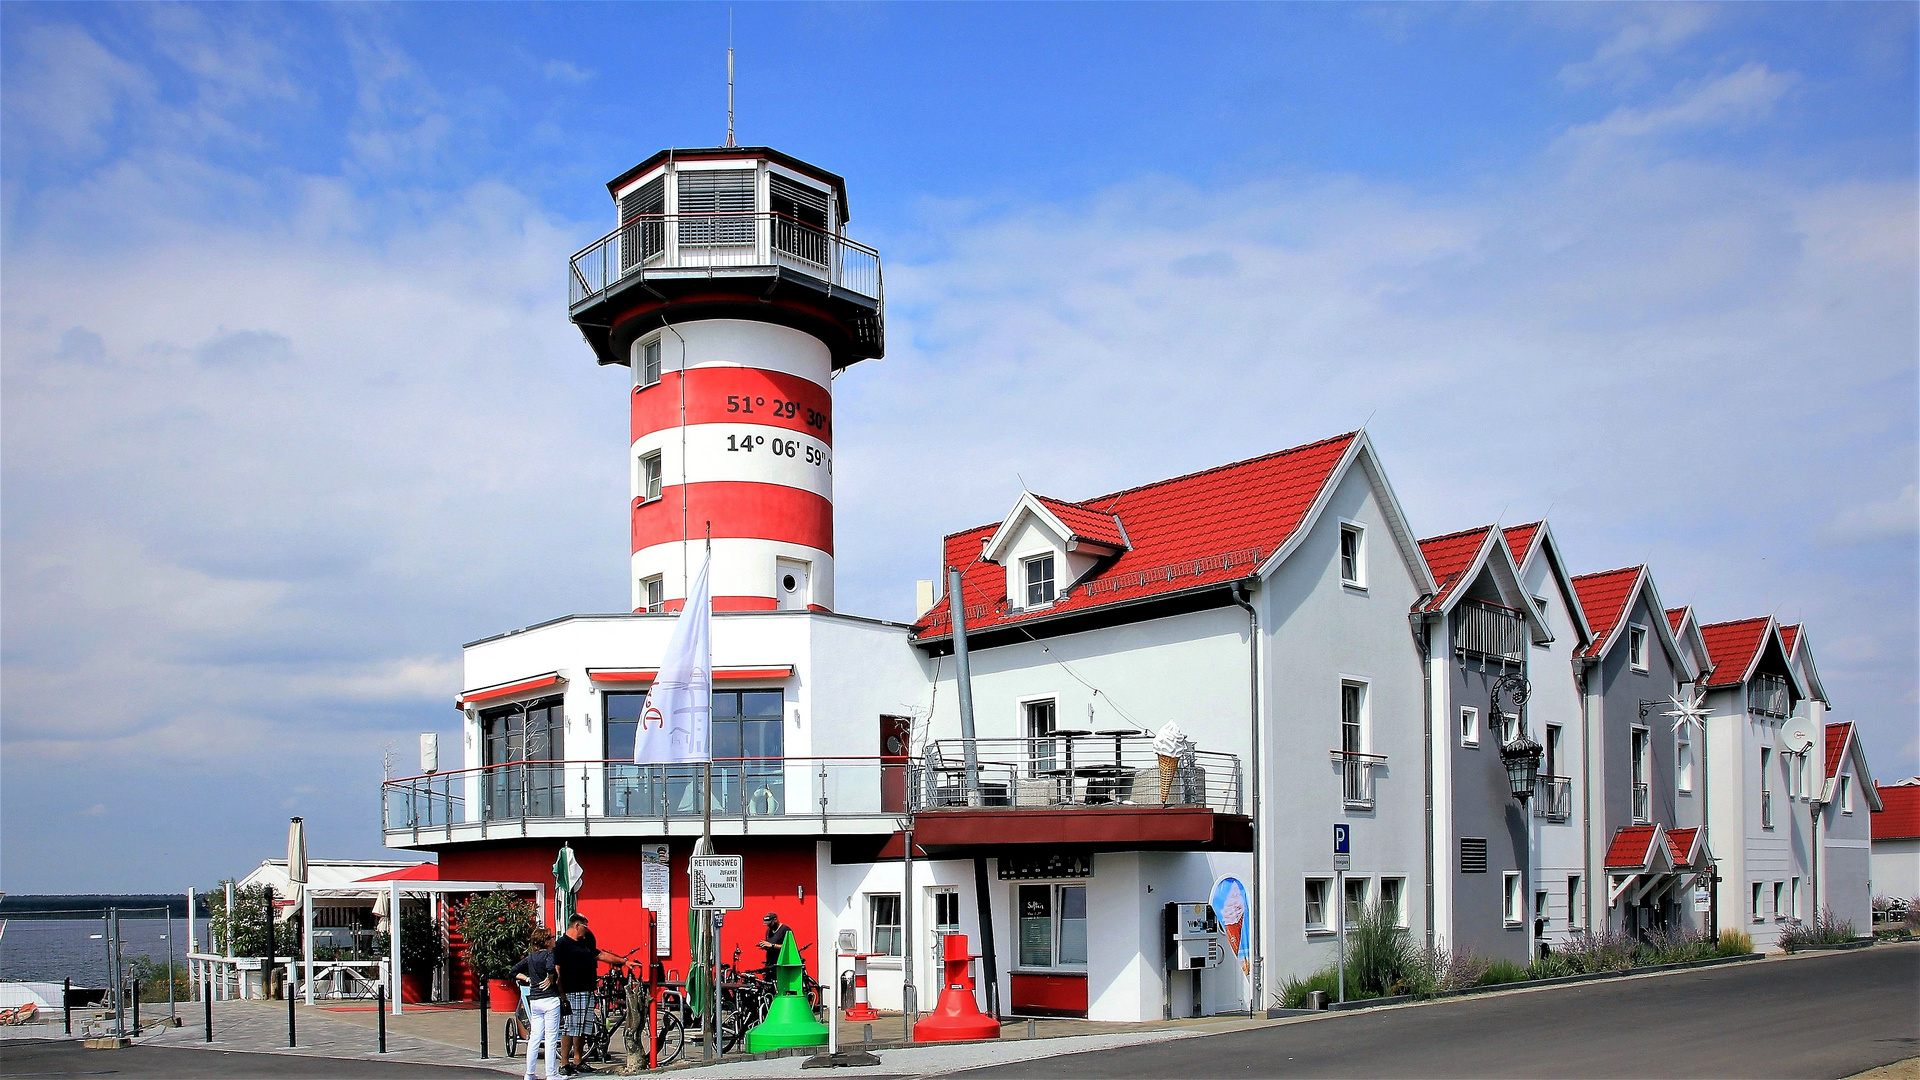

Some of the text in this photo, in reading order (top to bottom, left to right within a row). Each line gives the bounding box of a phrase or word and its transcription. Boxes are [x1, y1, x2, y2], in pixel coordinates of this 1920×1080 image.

[727, 395, 765, 413] 51°
[773, 399, 800, 419] 29'
[807, 408, 827, 430] 30"
[727, 434, 765, 452] 14°
[772, 438, 800, 458] 06'
[805, 445, 826, 467] 59"
[1336, 827, 1345, 850] P
